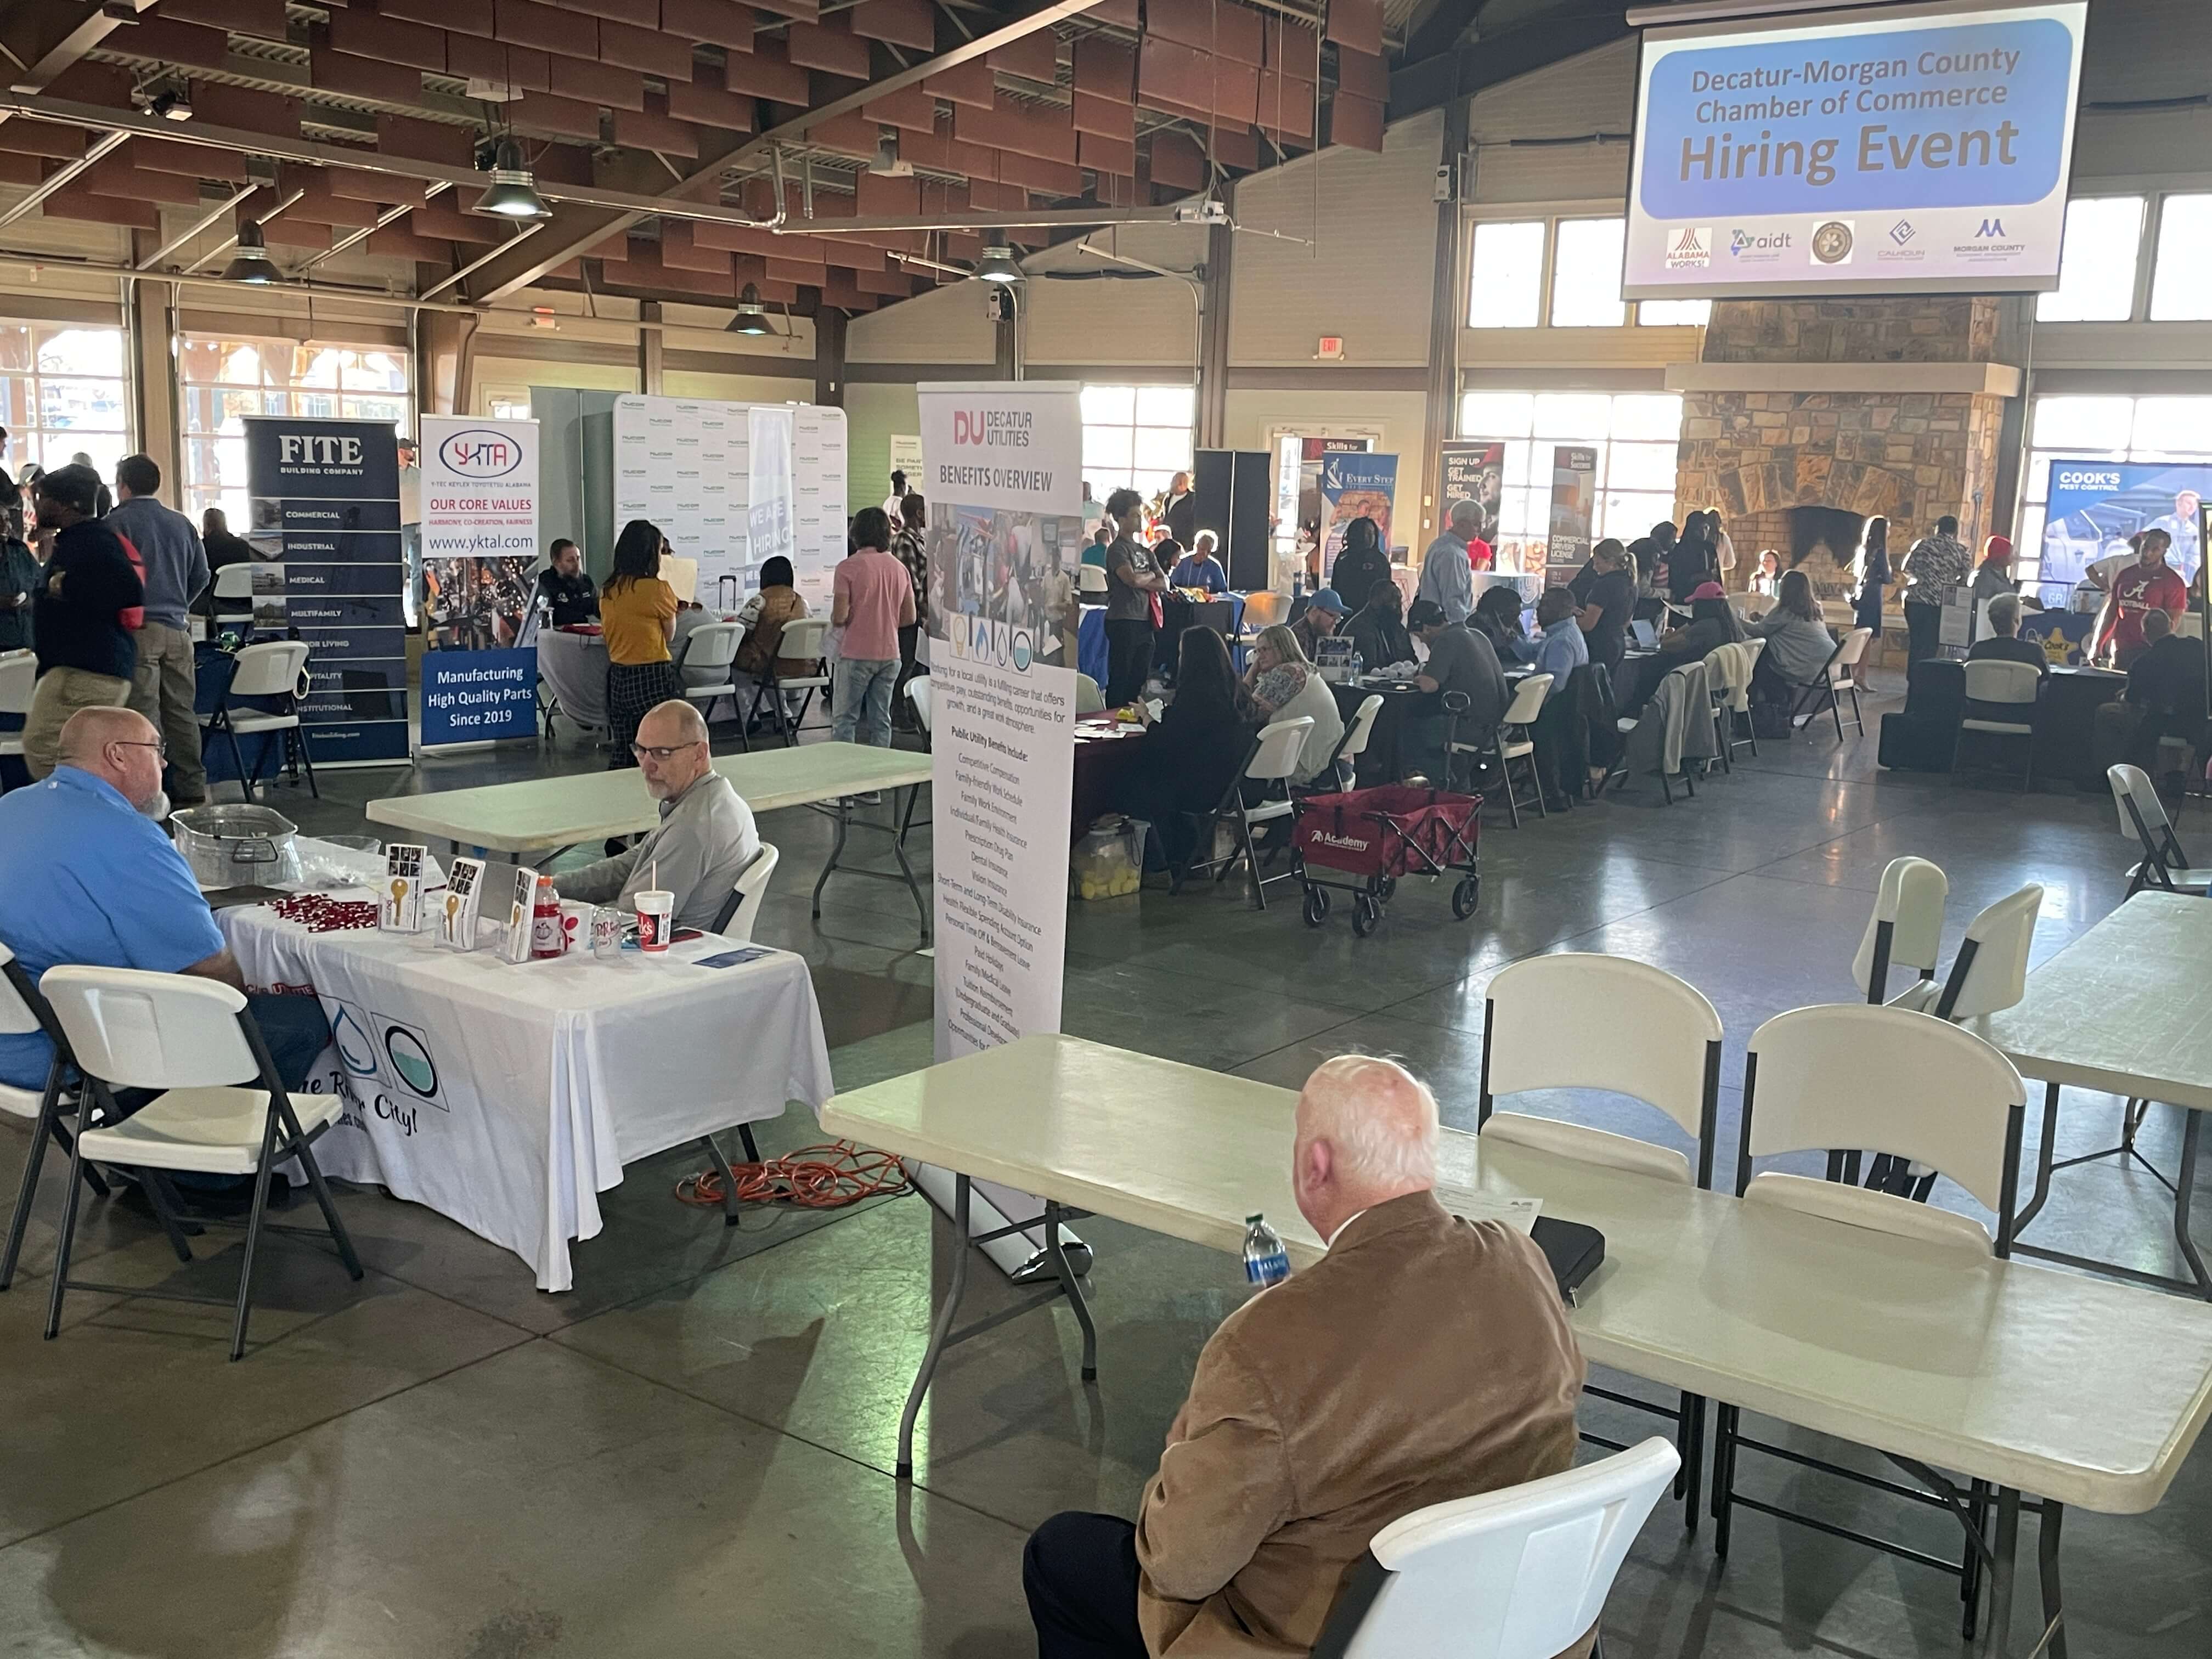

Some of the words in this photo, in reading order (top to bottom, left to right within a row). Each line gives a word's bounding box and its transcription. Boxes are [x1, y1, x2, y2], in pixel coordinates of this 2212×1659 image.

[1692, 59, 1908, 93] Decatur-Morgan
[1917, 48, 2021, 75] County
[1696, 95, 1813, 123] Chamber
[1821, 90, 1849, 115] of
[1856, 85, 2007, 112] Commerce
[1680, 130, 1839, 186] Hiring
[1858, 120, 2019, 171] Event
[1757, 233, 1792, 248] aidt
[1667, 251, 1709, 259] ALABAMA
[1671, 260, 1705, 268] WORKS!
[1323, 340, 1335, 352] EXIT
[954, 411, 985, 445] DU
[987, 411, 1032, 428] DECATUR
[987, 430, 1030, 447] UTILITIES
[1327, 441, 1348, 451] Skills
[279, 435, 363, 465] FITE
[455, 443, 507, 466] YKTA
[1448, 456, 1468, 466] SIGN
[1469, 458, 1481, 466] UP
[940, 465, 991, 487] BENEFITS
[994, 468, 1053, 492] OVERVIEW
[1448, 466, 1464, 475] GET
[1448, 474, 1483, 483] TRAINED
[2059, 471, 2120, 484] COOK'S
[1447, 484, 1463, 492] GET
[430, 499, 455, 510] OUR
[459, 499, 488, 510] CORE
[492, 499, 532, 510] VALUES
[749, 509, 764, 528] WE
[429, 534, 533, 552] www.yktal.com
[1552, 534, 1589, 545] COMMERCIAL
[438, 667, 523, 684] Manufacturing
[428, 692, 455, 709] High
[459, 689, 500, 706] Quality
[504, 688, 532, 701] Parts
[1031, 688, 1042, 702] that
[1043, 692, 1065, 707] offers
[450, 713, 481, 727] Since
[484, 709, 512, 724] 2019
[967, 704, 977, 714] and
[1014, 703, 1052, 721] opportunities
[1054, 710, 1066, 724] for
[951, 725, 969, 741] Public
[969, 730, 988, 749] Utility
[988, 737, 1007, 753] Benefits
[958, 752, 989, 772] Competitive
[961, 790, 978, 808] Family
[375, 1094, 417, 1137] City!
